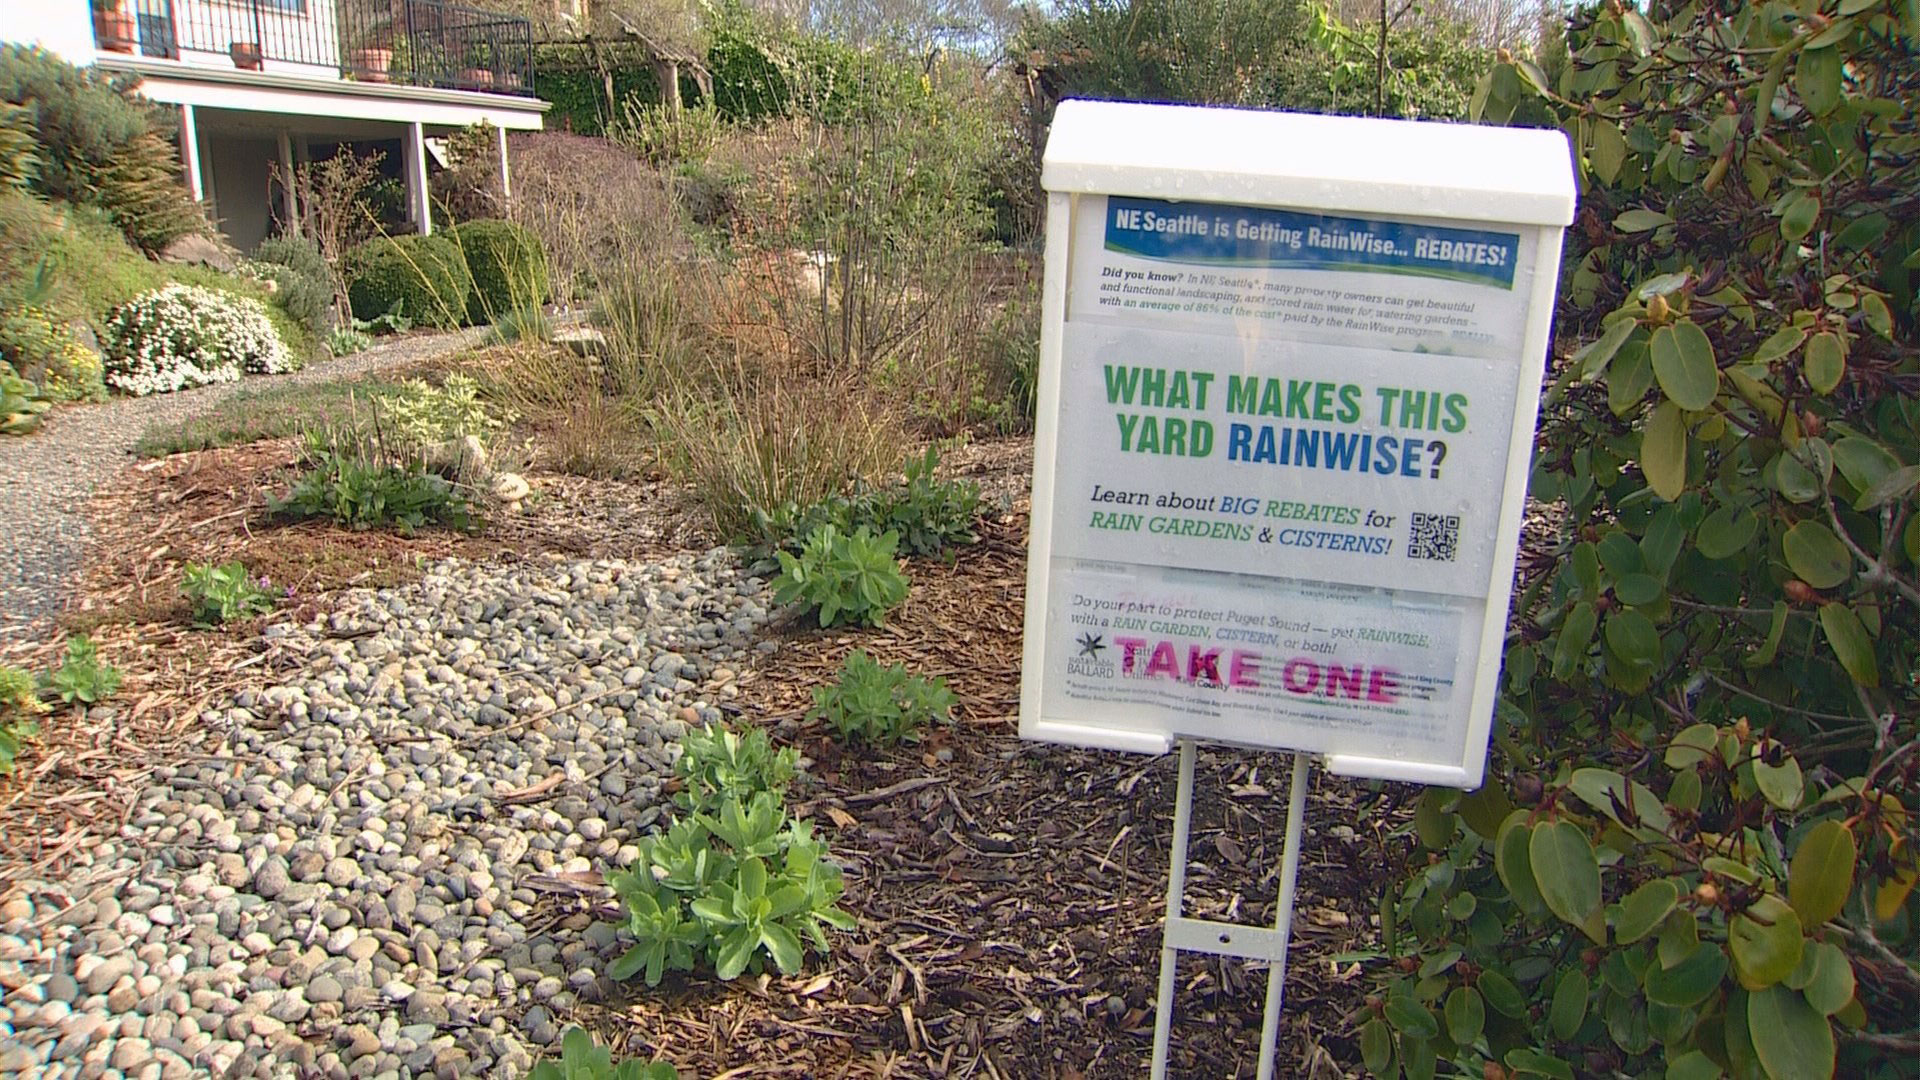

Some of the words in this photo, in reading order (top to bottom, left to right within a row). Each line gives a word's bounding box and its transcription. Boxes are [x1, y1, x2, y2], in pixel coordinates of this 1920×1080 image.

[1214, 217, 1230, 237] is
[1236, 219, 1303, 249] Getting
[1308, 226, 1408, 257] RainWise...
[1414, 237, 1508, 266] REBATES!
[1100, 282, 1121, 292] and
[1122, 283, 1176, 297] functional
[1176, 289, 1242, 304] landscaping,
[1244, 295, 1265, 304] and
[1303, 301, 1323, 310] rain
[1327, 304, 1355, 314] water
[1425, 312, 1468, 327] gardens
[1102, 267, 1123, 278] Did
[1125, 270, 1145, 281] you
[1147, 271, 1184, 282] know?
[1187, 274, 1198, 284] In
[1264, 281, 1293, 295] many
[1343, 292, 1383, 304] owners
[1384, 297, 1404, 306] can
[1406, 298, 1425, 309] get
[1427, 300, 1475, 313] beautiful
[1099, 296, 1121, 306] with
[1123, 299, 1137, 308] an
[1139, 300, 1181, 313] average
[1183, 302, 1194, 312] of
[1221, 306, 1233, 316] of
[1235, 306, 1252, 317] the
[1283, 313, 1308, 323] paid
[1311, 315, 1325, 328] by
[1326, 316, 1343, 327] the
[1345, 318, 1395, 333] RainWise
[1104, 364, 1215, 411] WHAT
[1226, 374, 1362, 424] MAKES
[1376, 387, 1468, 433] THIS
[1116, 413, 1214, 457] YARD
[1228, 423, 1447, 479] RAINWISE?
[1091, 485, 1149, 506] Learn
[1156, 491, 1215, 511] about
[1219, 496, 1260, 515] BIG
[1263, 500, 1361, 525] REBATES
[1365, 509, 1397, 528] for
[1089, 511, 1144, 531] RAIN
[1148, 516, 1254, 541] GARDENS
[1258, 527, 1274, 543] &
[1279, 528, 1393, 555] CISTERNS!
[1071, 613, 1098, 626] with
[1101, 618, 1110, 627] a
[1112, 616, 1147, 630] RAIN
[1150, 621, 1211, 640] GARDEN,
[1216, 627, 1280, 648] CISTERN,
[1284, 639, 1299, 650] or
[1302, 636, 1337, 655] both!
[1073, 594, 1091, 607] Do
[1093, 599, 1125, 610] your
[1126, 601, 1155, 613] part
[1158, 604, 1171, 616] to
[1173, 607, 1223, 620] protect
[1226, 610, 1265, 626] Puget
[1268, 616, 1310, 633] Sound
[1331, 626, 1353, 640] get
[1067, 663, 1114, 679] BALLARD
[1113, 633, 1262, 689] TAKE
[1283, 656, 1400, 705] ONE
[1197, 679, 1230, 693] County
